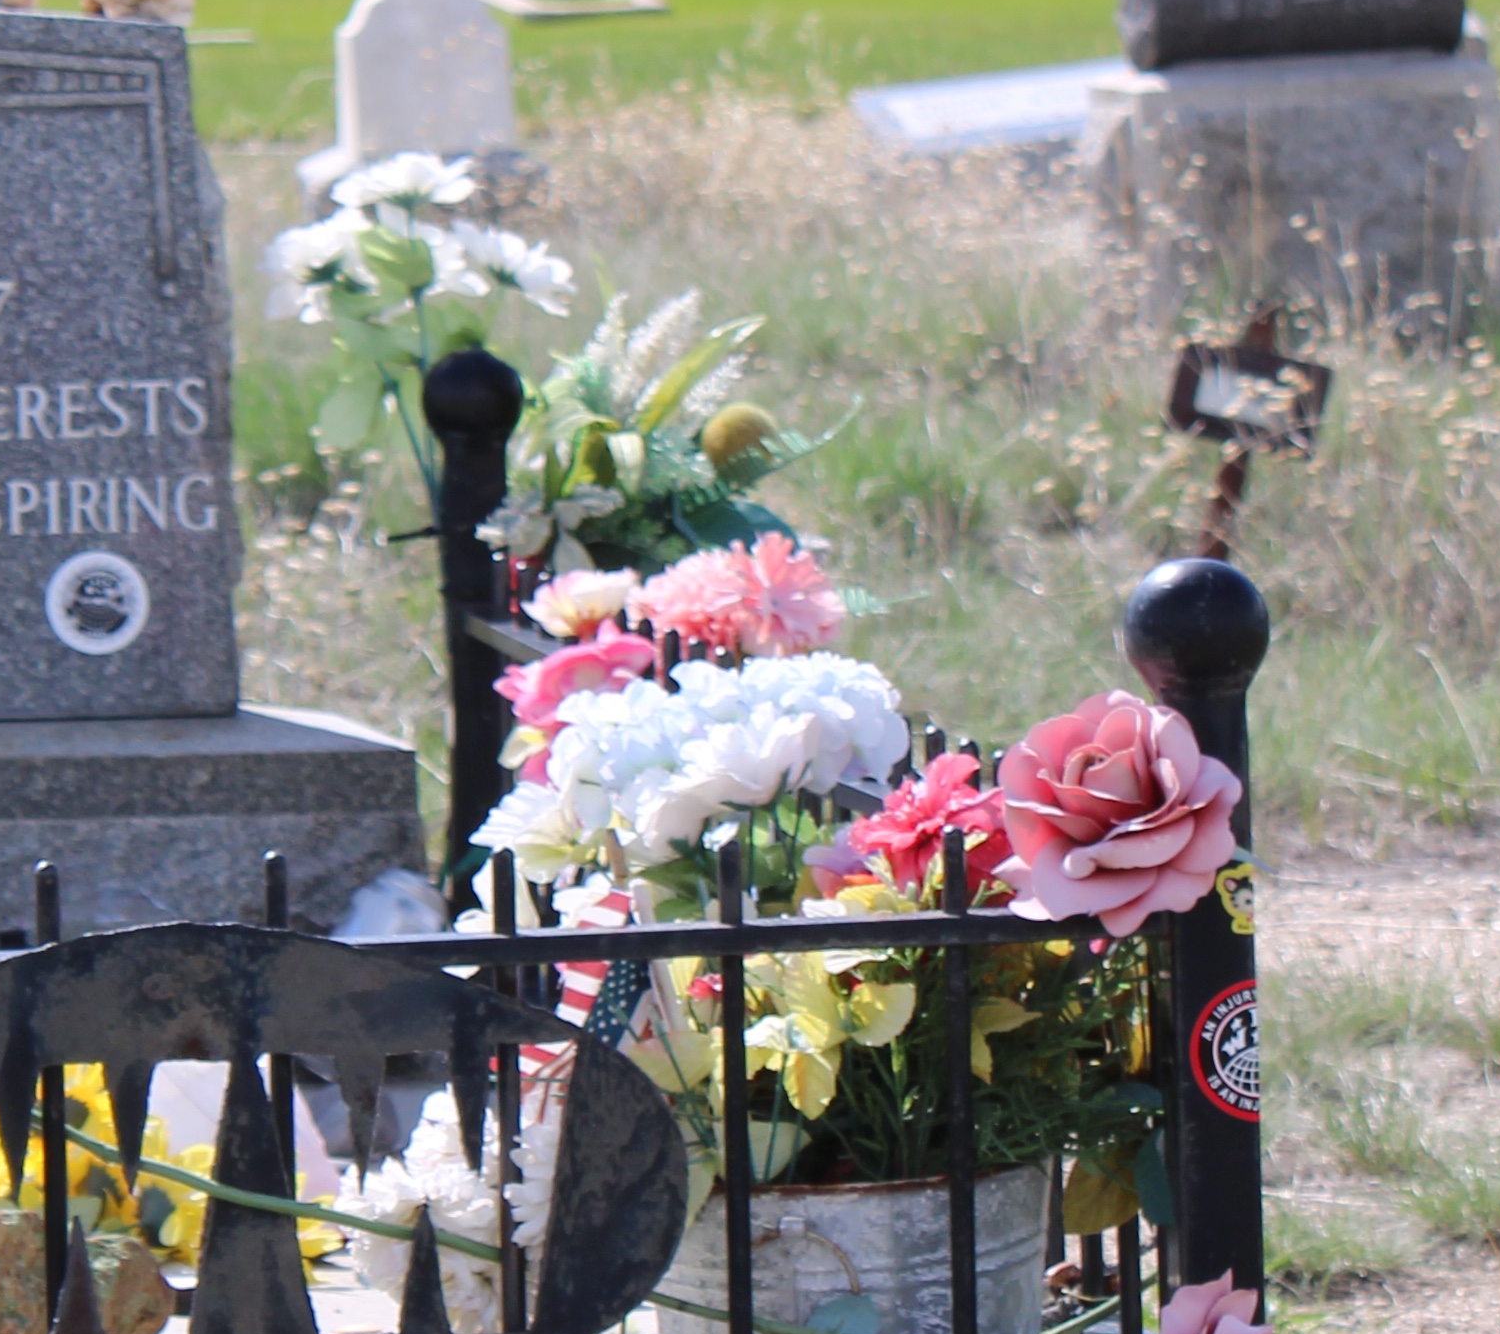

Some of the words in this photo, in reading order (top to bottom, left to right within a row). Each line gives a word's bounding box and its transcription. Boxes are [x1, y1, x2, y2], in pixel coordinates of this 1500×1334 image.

[1201, 1020, 1218, 1042] AN
[1206, 1074, 1223, 1090] IS
[1218, 1088, 1239, 1105] AN
